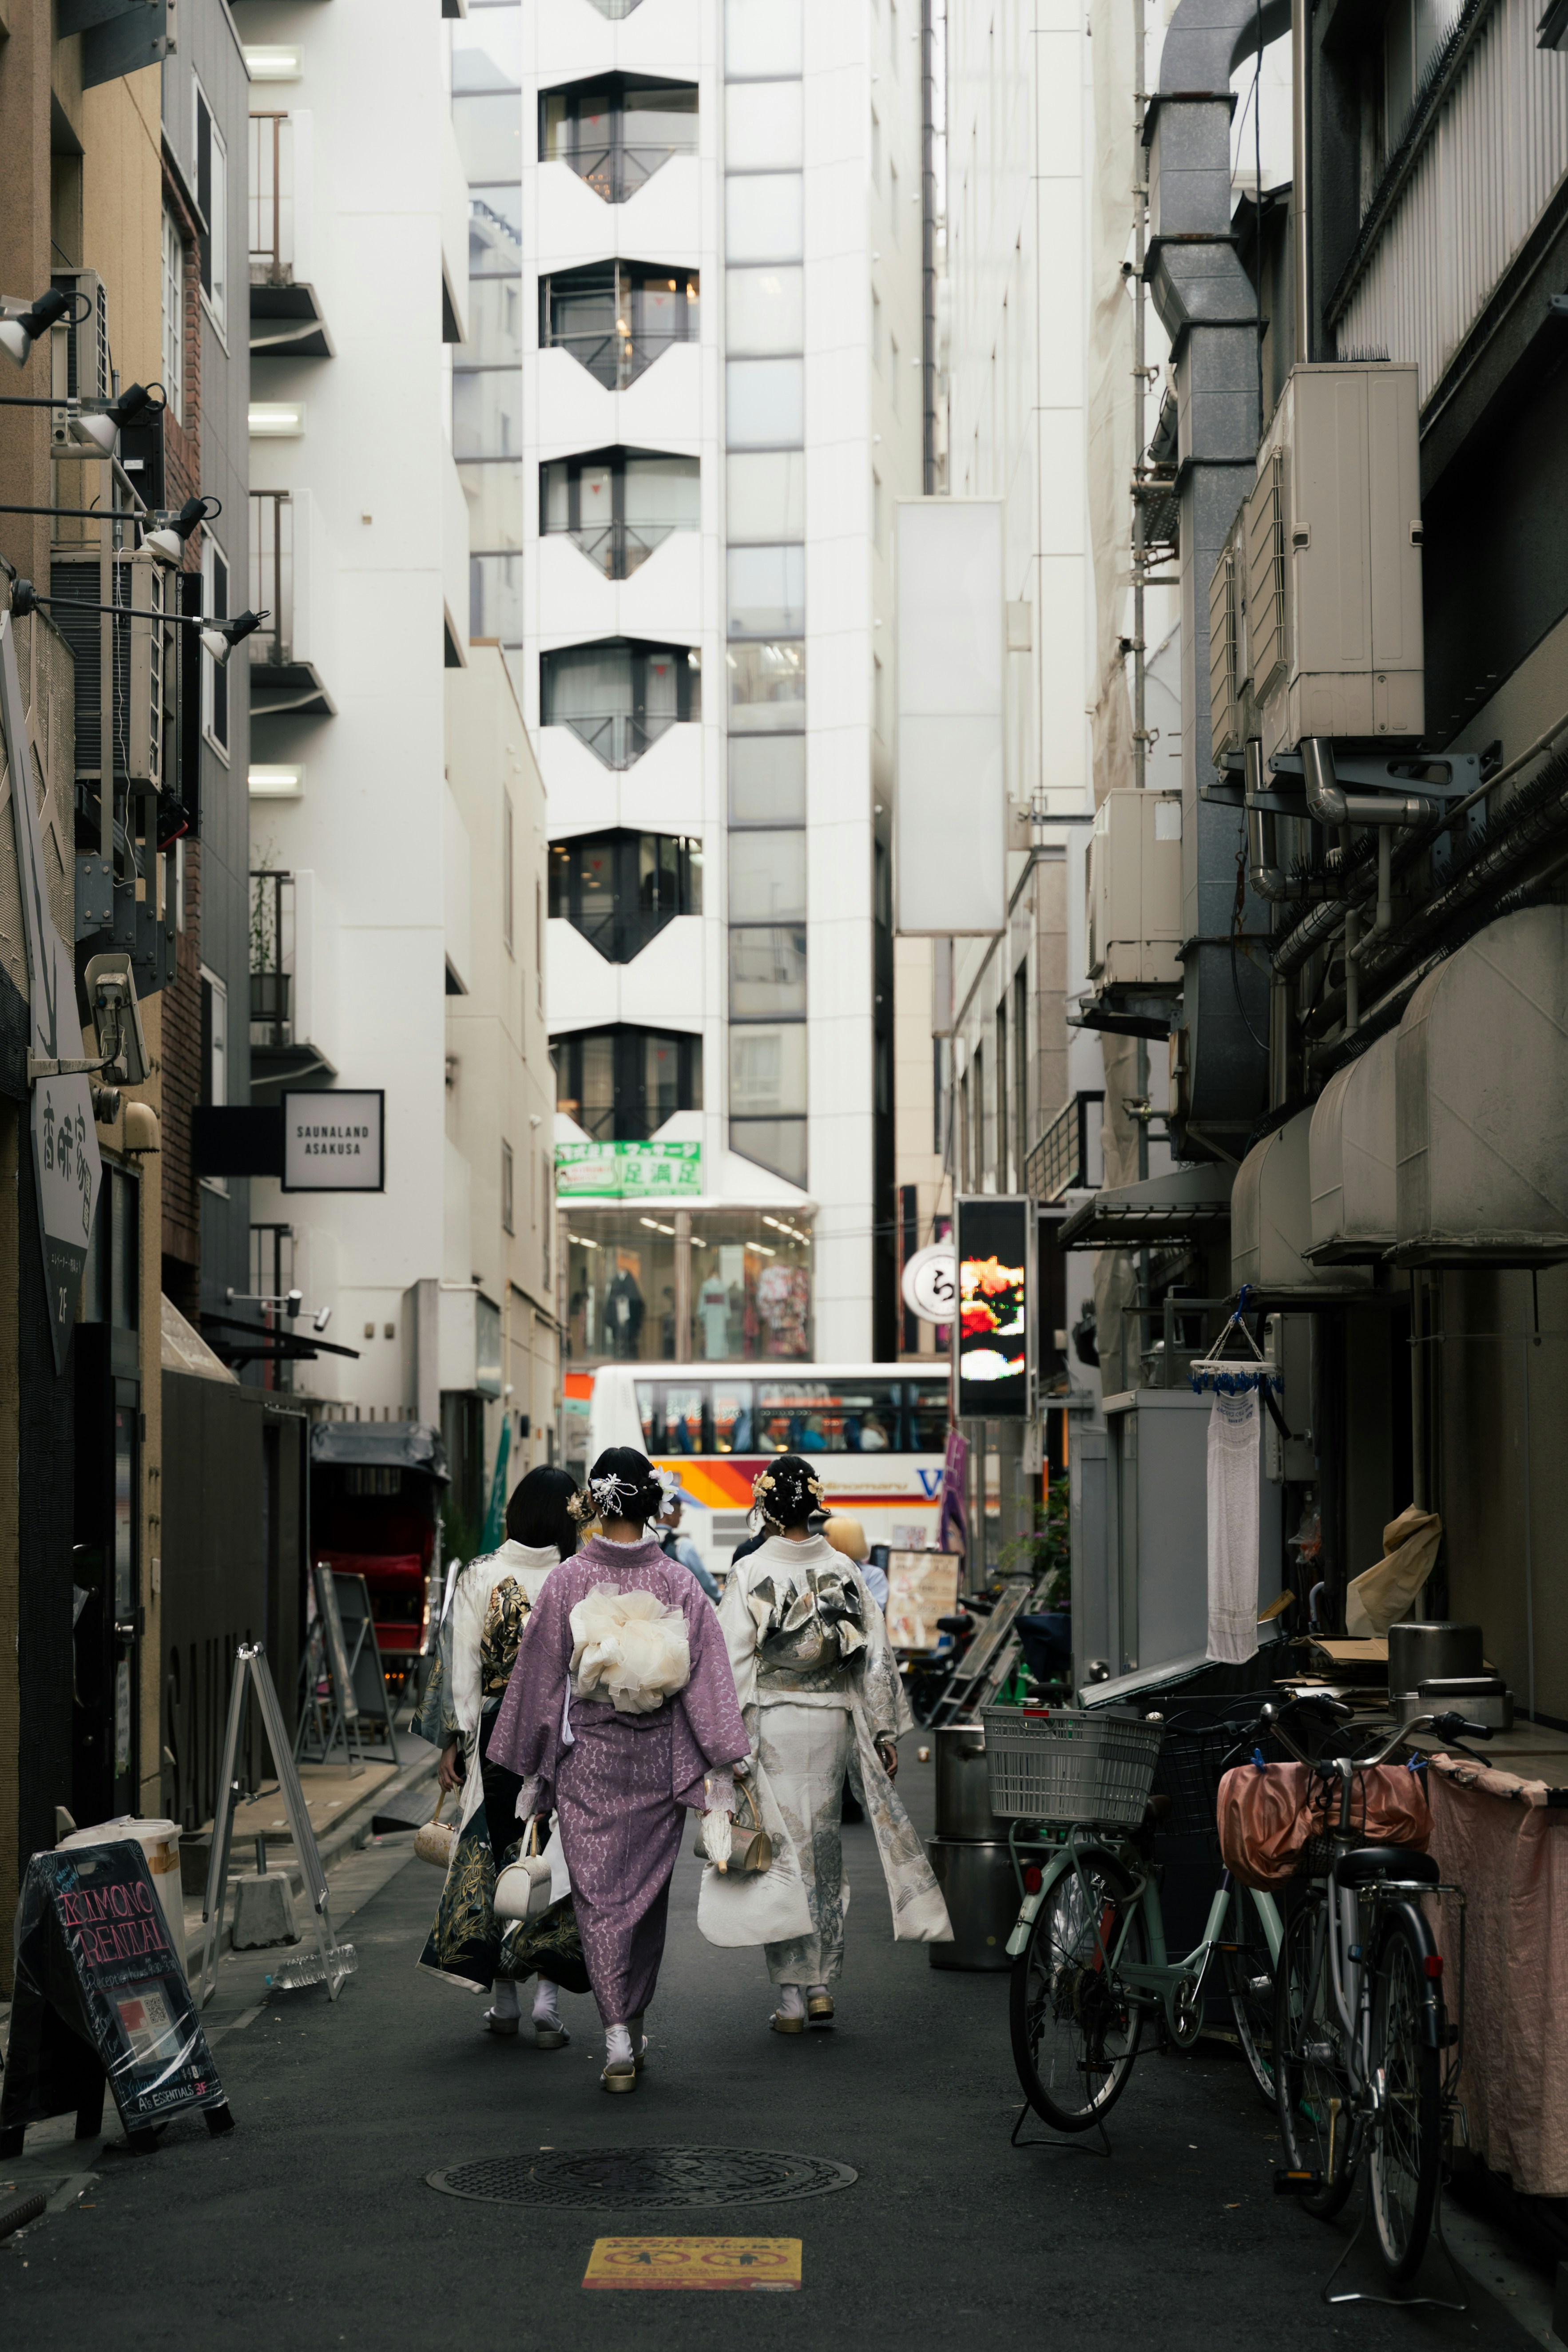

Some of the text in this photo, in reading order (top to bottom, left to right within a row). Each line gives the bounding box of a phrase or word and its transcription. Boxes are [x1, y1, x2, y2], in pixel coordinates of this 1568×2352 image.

[297, 1126, 368, 1138] SAUNALAND
[305, 1143, 360, 1154] ASAKUSA
[59, 1286, 67, 1324] 2F
[56, 1864, 70, 1884] New
[58, 1881, 153, 1927] KIMONO
[76, 1917, 169, 1967] RENTAL
[87, 1972, 127, 1990] Reception
[139, 2081, 207, 2112] A's ESSENTIALS 3F
